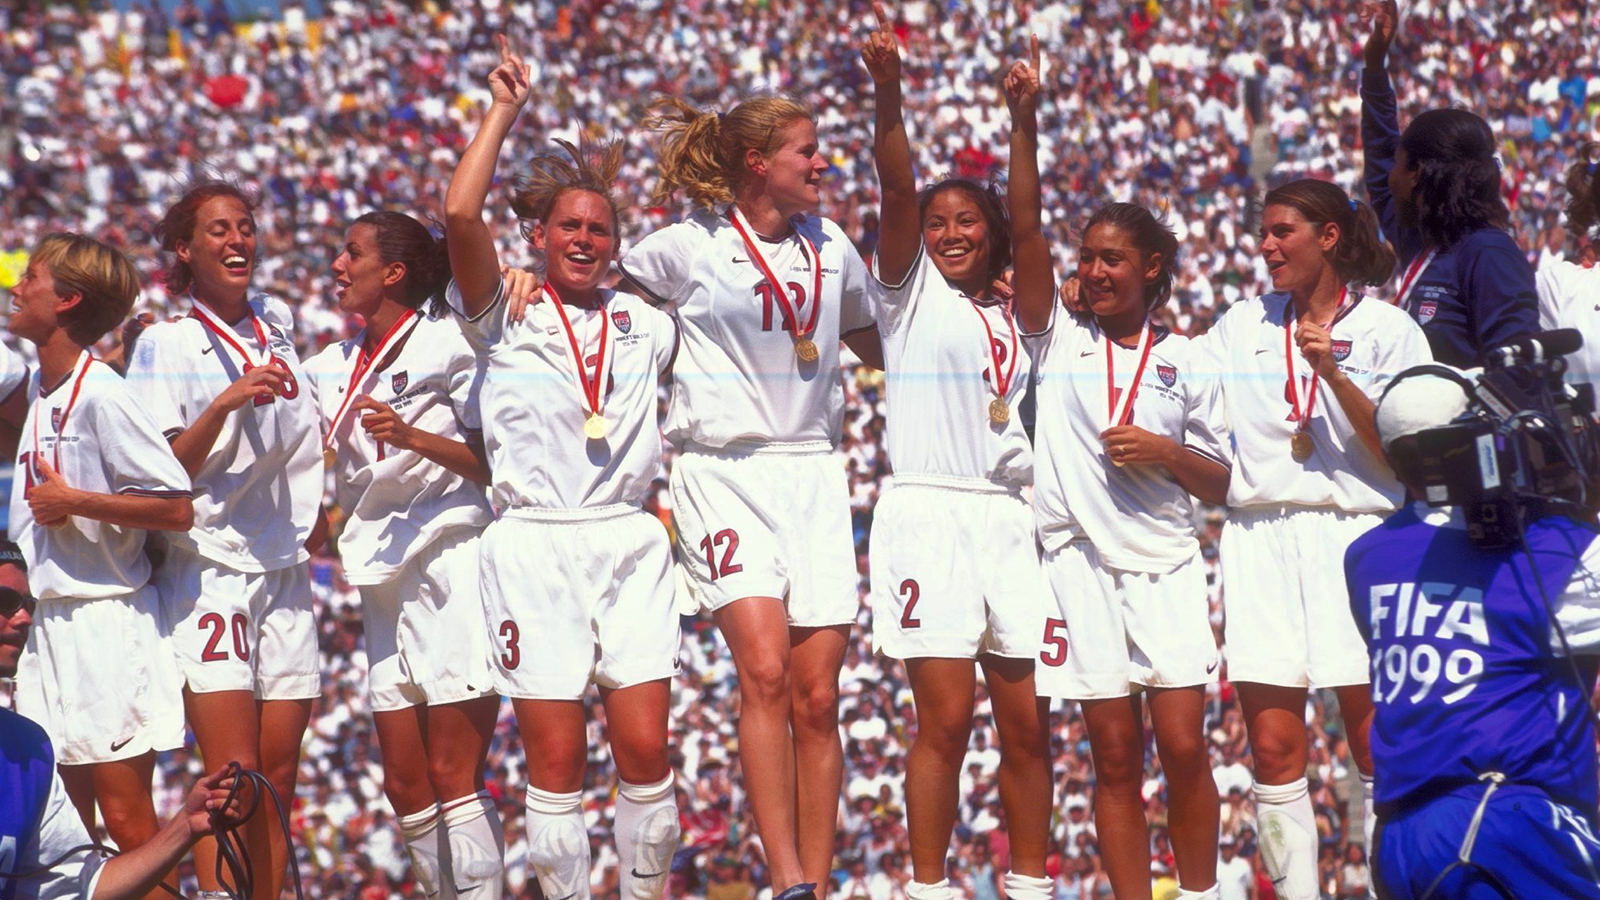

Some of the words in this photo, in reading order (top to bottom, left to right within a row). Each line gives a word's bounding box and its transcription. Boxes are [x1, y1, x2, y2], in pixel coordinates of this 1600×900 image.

[700, 528, 743, 582] 12
[899, 578, 921, 629] 2
[1369, 580, 1491, 648] FIFA
[197, 611, 251, 663] 20
[499, 619, 521, 671] 3
[1039, 616, 1068, 668] 5
[1371, 643, 1485, 705] 1999
